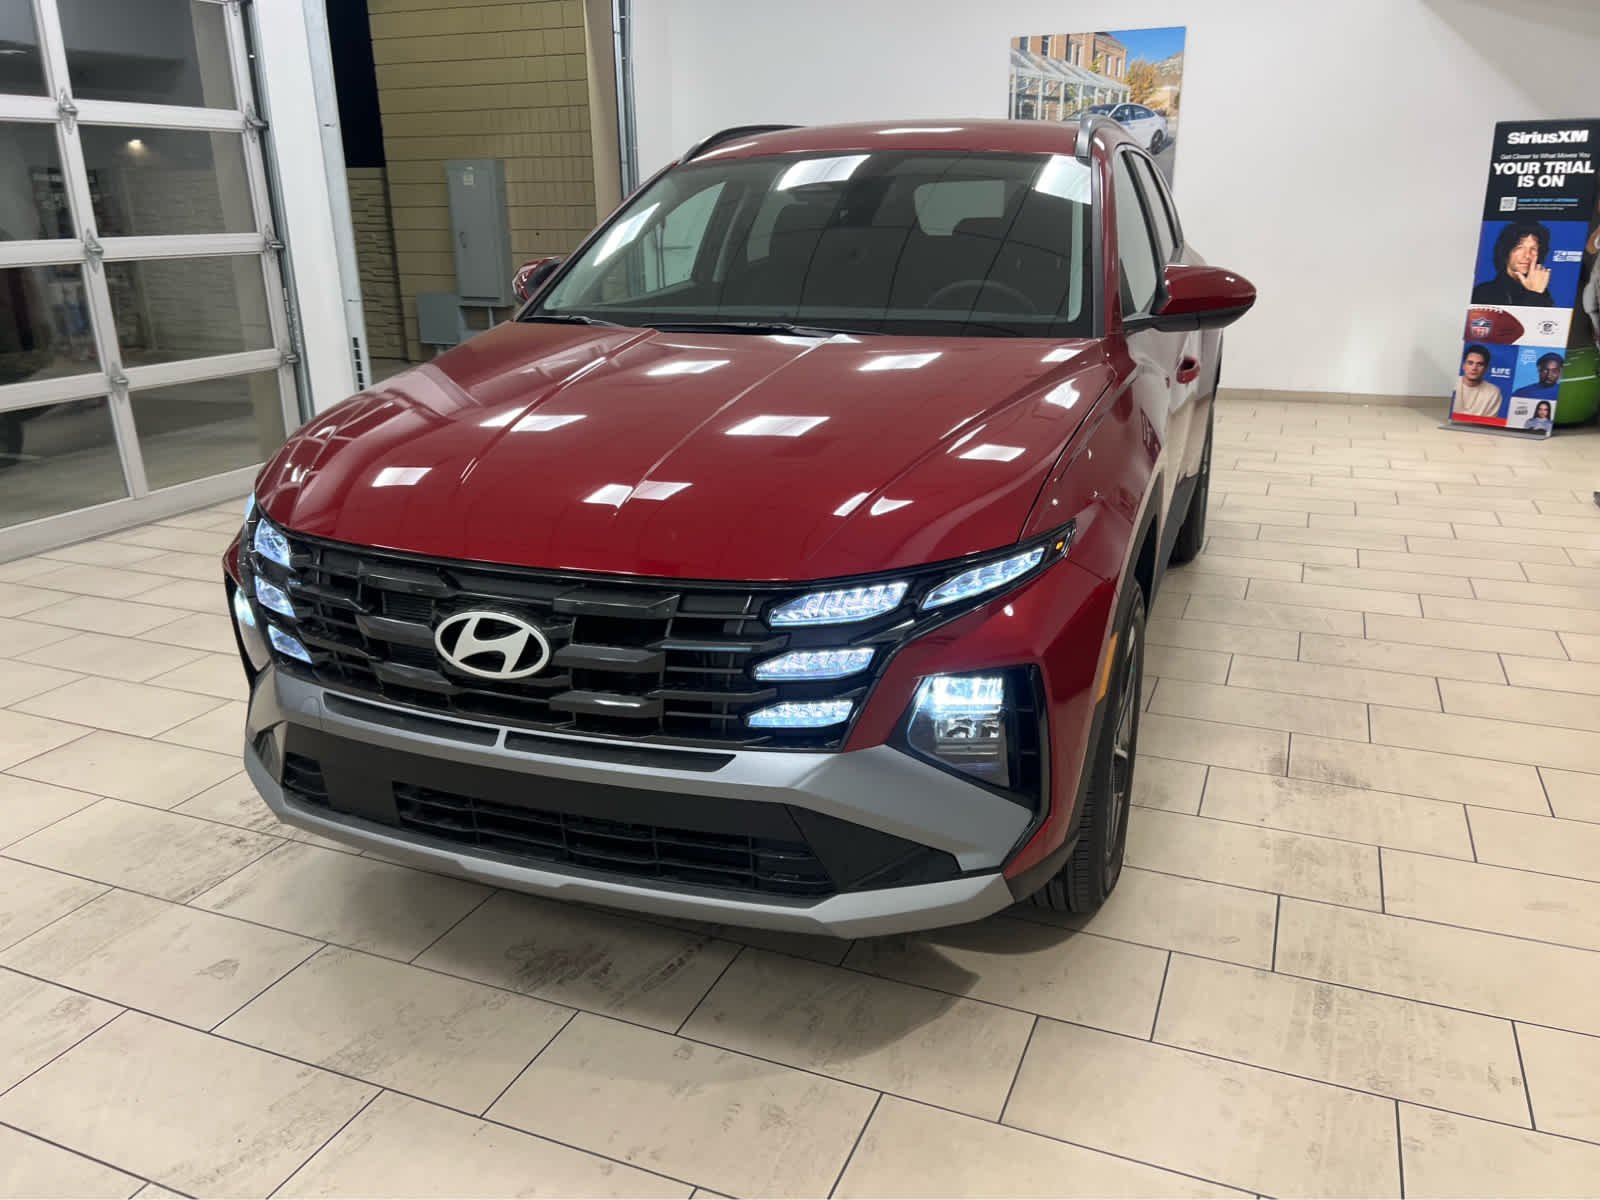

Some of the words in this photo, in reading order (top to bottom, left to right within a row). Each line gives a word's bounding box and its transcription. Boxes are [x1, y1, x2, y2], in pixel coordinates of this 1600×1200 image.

[1507, 129, 1589, 144] SiriusXM
[1493, 162, 1540, 175] YOUR
[1543, 160, 1595, 174] TRIAL
[1517, 174, 1535, 188] IS
[1537, 174, 1566, 188] ON
